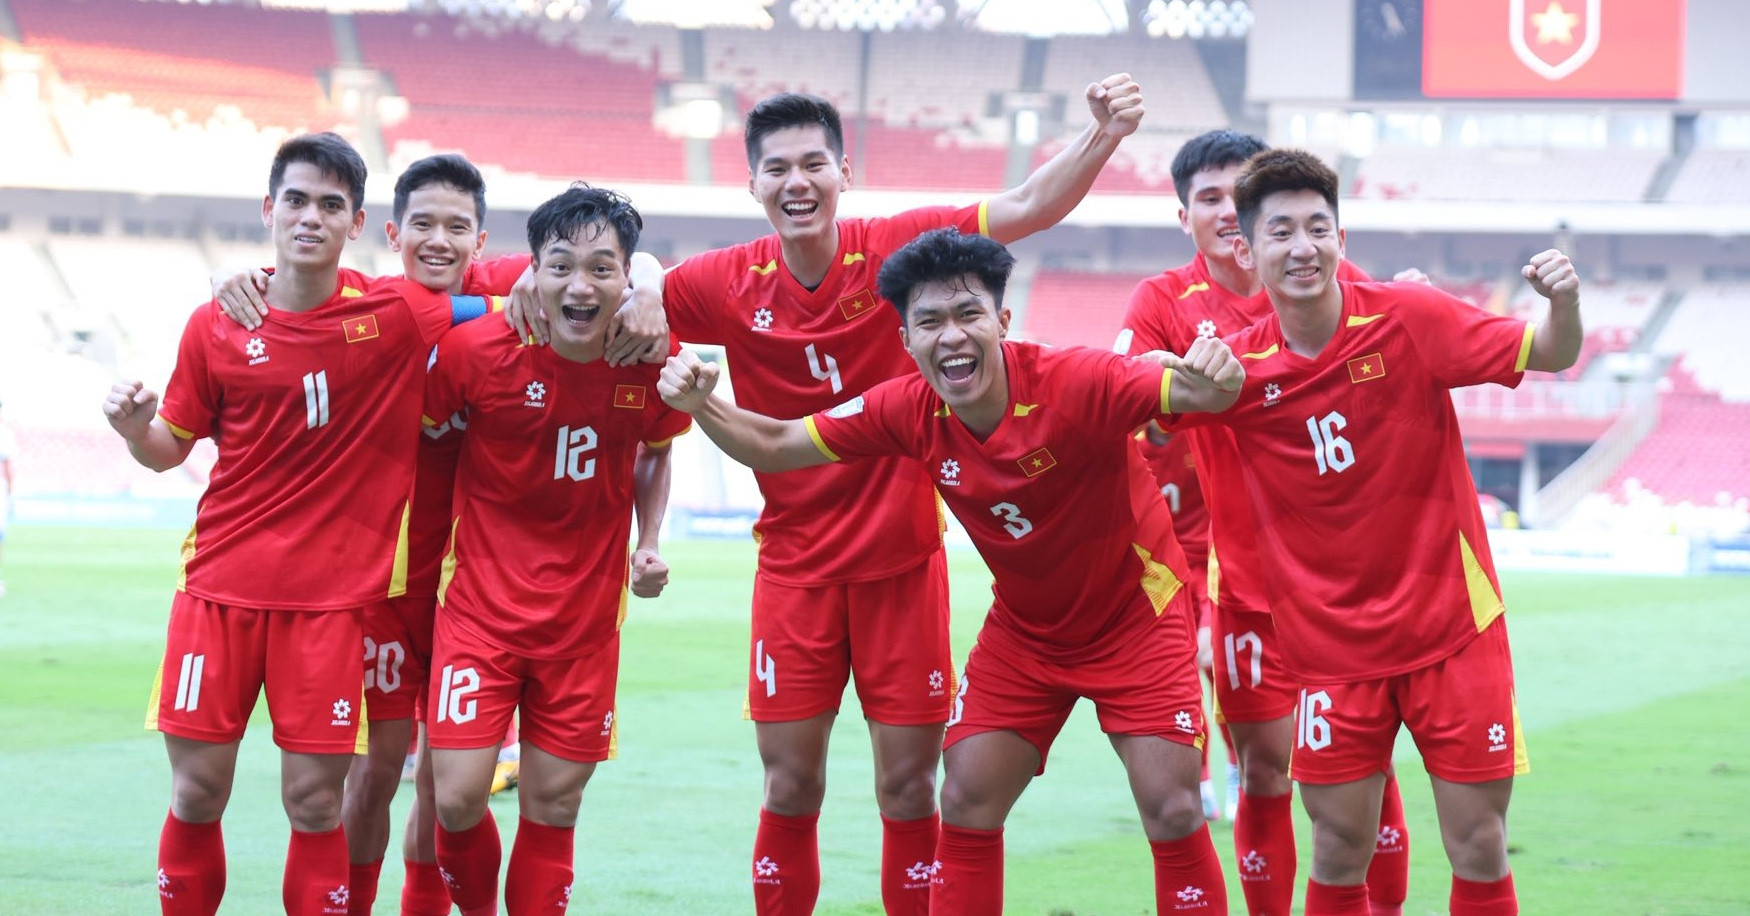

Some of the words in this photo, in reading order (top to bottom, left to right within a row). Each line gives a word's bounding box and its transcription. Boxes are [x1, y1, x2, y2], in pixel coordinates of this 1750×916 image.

[805, 344, 842, 395] 4
[303, 370, 330, 429] 11
[554, 425, 598, 482] 12
[1306, 411, 1356, 475] 16
[990, 502, 1033, 540] 3
[174, 653, 205, 712] 11
[755, 639, 777, 698] 4
[1224, 632, 1263, 689] 17
[437, 664, 481, 726] 12
[1297, 688, 1333, 751] 16
